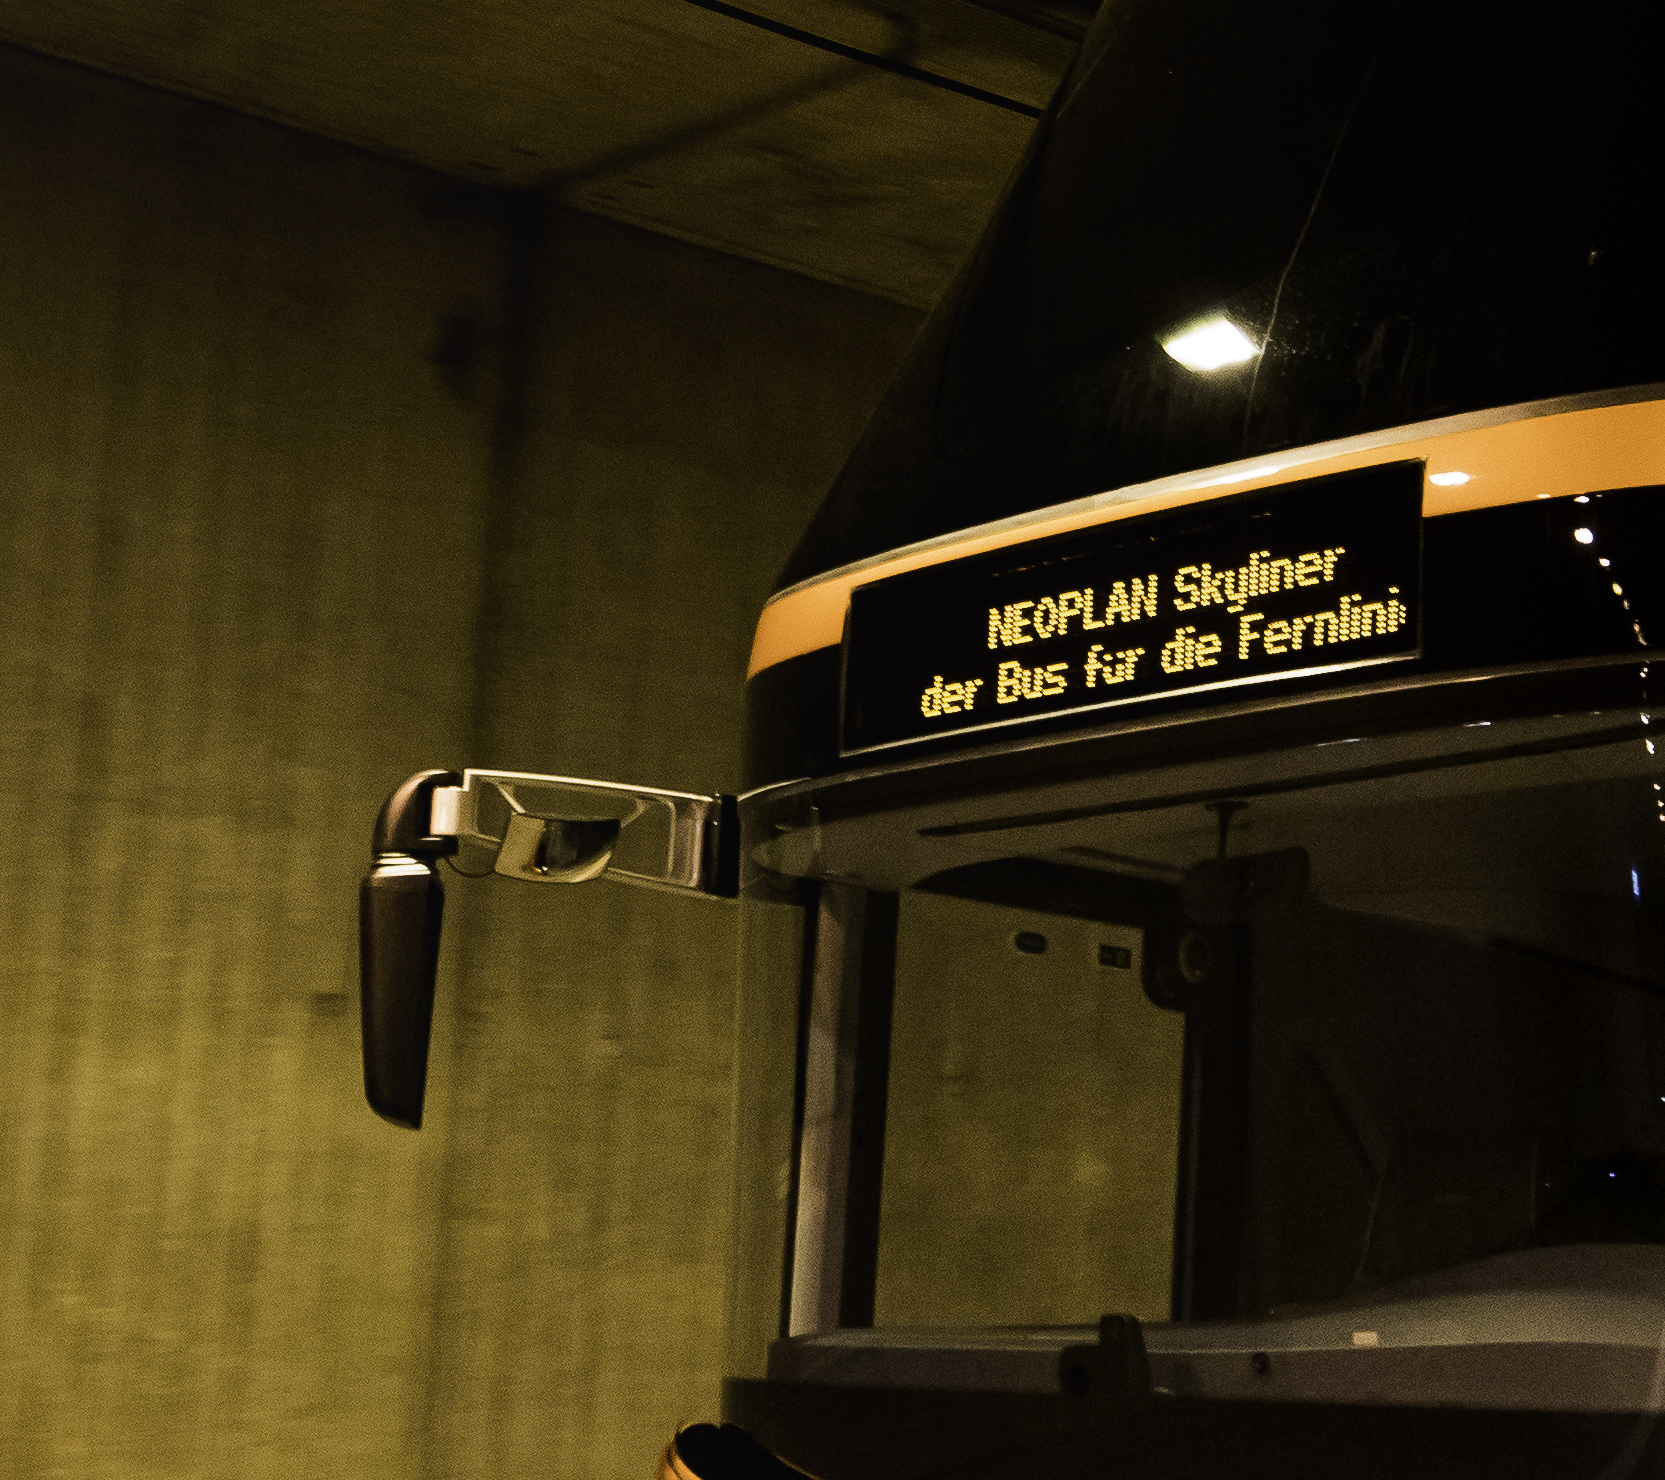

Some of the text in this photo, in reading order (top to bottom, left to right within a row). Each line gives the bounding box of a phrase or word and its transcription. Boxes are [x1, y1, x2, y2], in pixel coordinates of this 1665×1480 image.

[988, 546, 1346, 650] NEOPLAN Skyliner
[921, 675, 984, 718] der
[997, 660, 1069, 705] Bus
[1084, 644, 1146, 688] für
[1161, 626, 1222, 673] die
